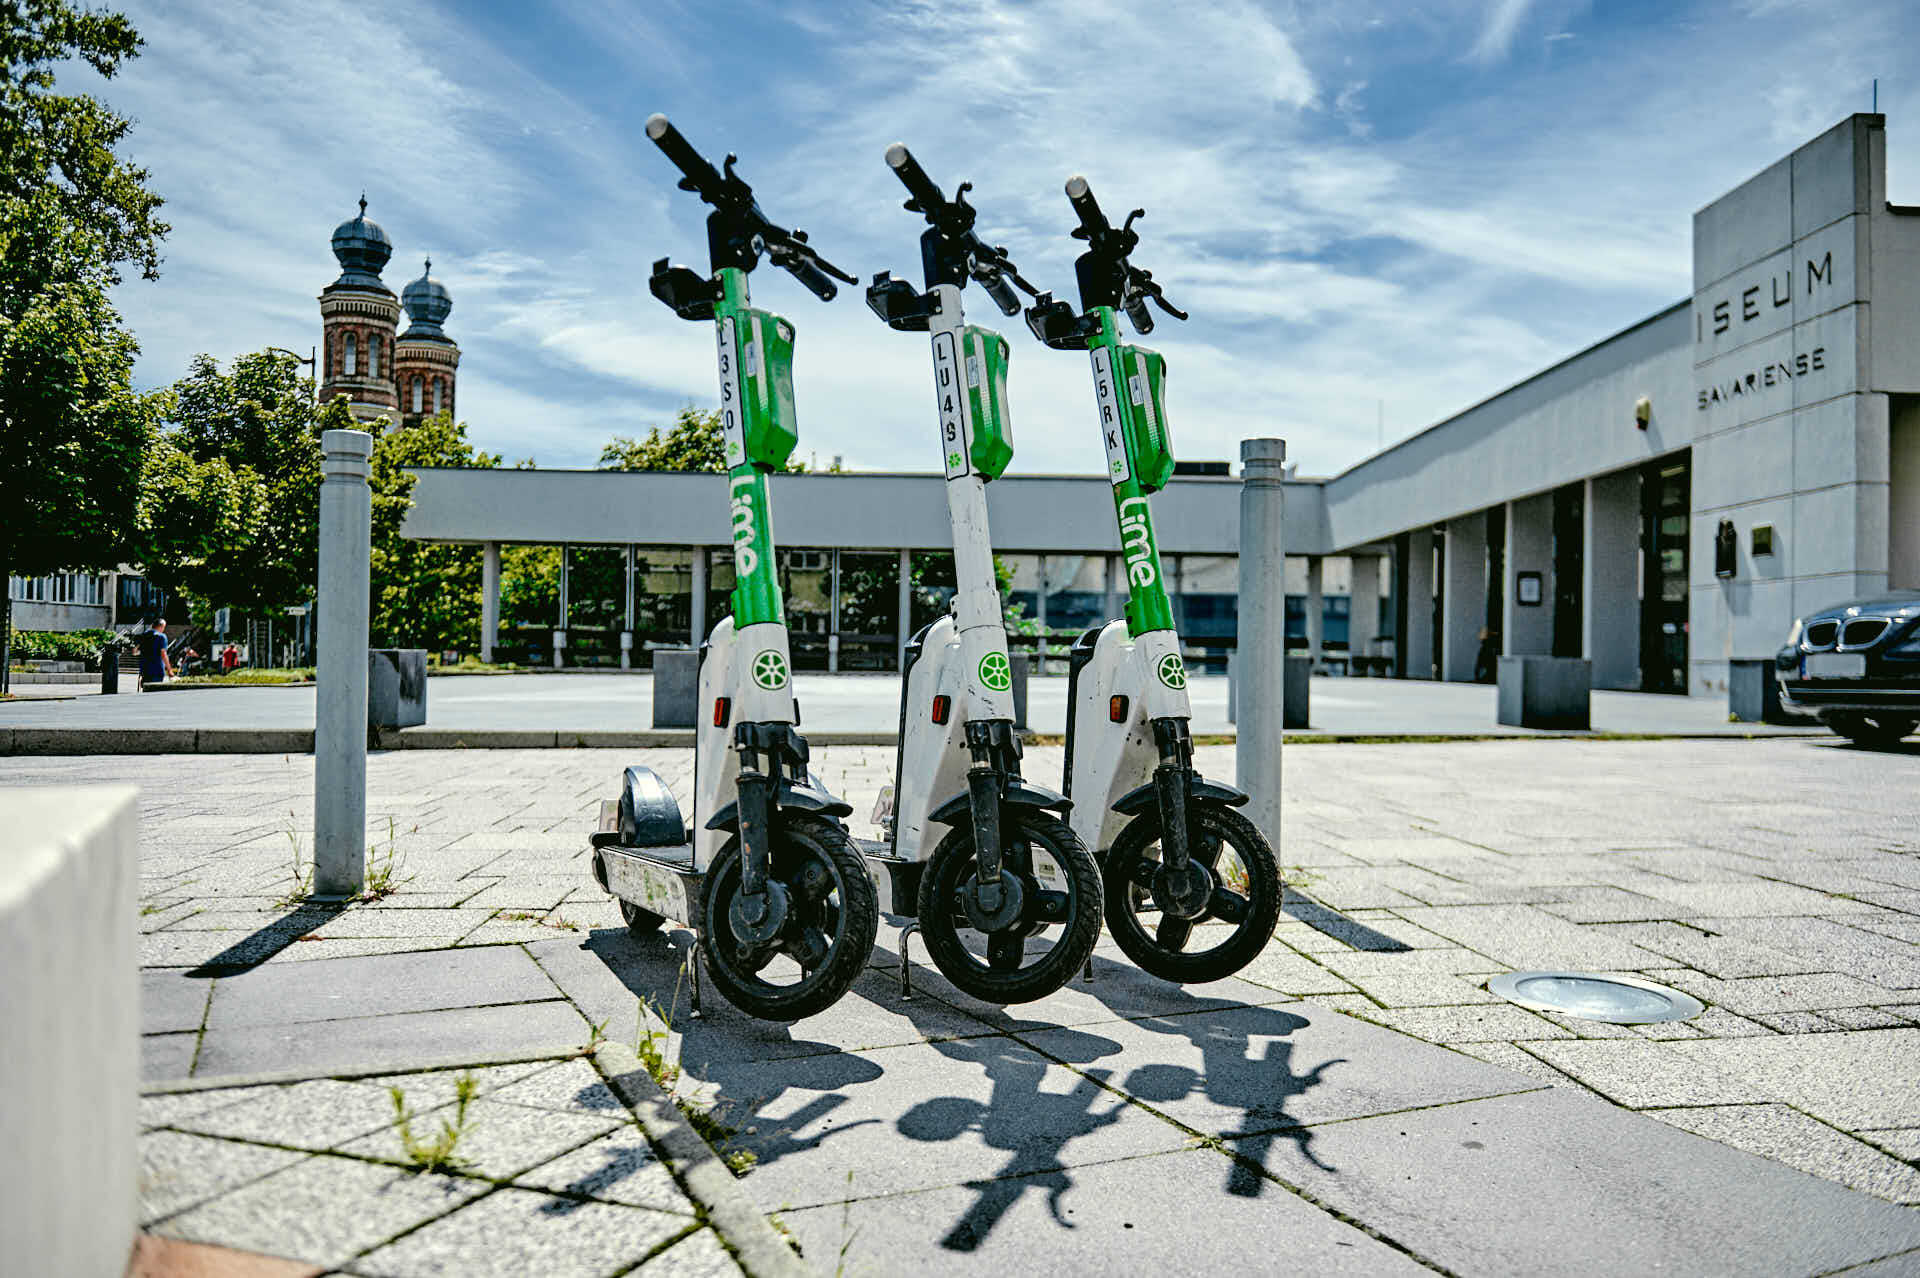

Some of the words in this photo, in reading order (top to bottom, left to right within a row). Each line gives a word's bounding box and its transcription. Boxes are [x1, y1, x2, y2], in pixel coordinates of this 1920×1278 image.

[1697, 251, 1832, 343] ISEUM
[1095, 357, 1118, 449] L5RK
[1698, 347, 1825, 411] SAVARIENSE
[1119, 497, 1156, 588] Lime
